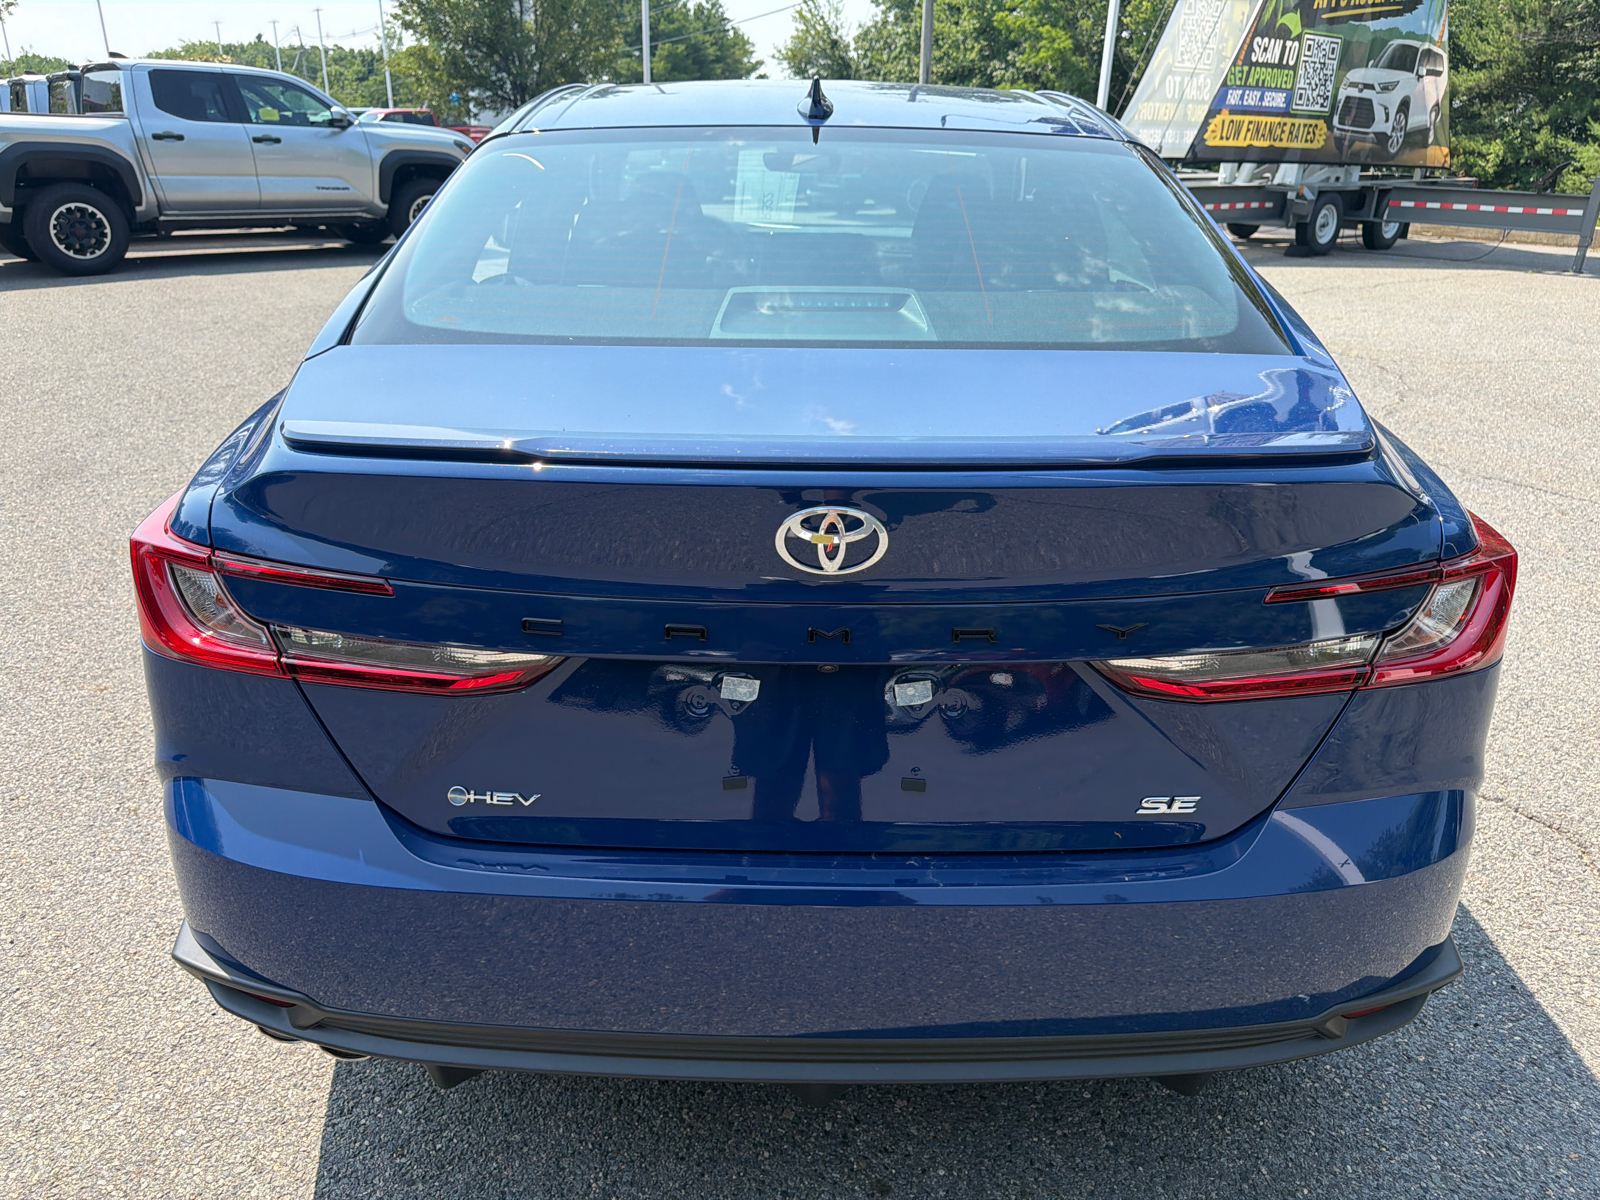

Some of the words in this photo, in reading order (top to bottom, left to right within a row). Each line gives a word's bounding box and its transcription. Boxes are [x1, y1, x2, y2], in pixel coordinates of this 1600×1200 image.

[1251, 36, 1283, 64] SCAN
[1282, 40, 1300, 66] TO
[1226, 65, 1249, 86] GET
[1247, 66, 1294, 89] APPROVED
[1243, 90, 1262, 106] EASY.
[1219, 119, 1245, 141] LOW
[1246, 120, 1287, 142] FINANCE
[1286, 122, 1318, 144] RATES
[521, 617, 1149, 643] CAMRY
[1135, 796, 1202, 814] SE
